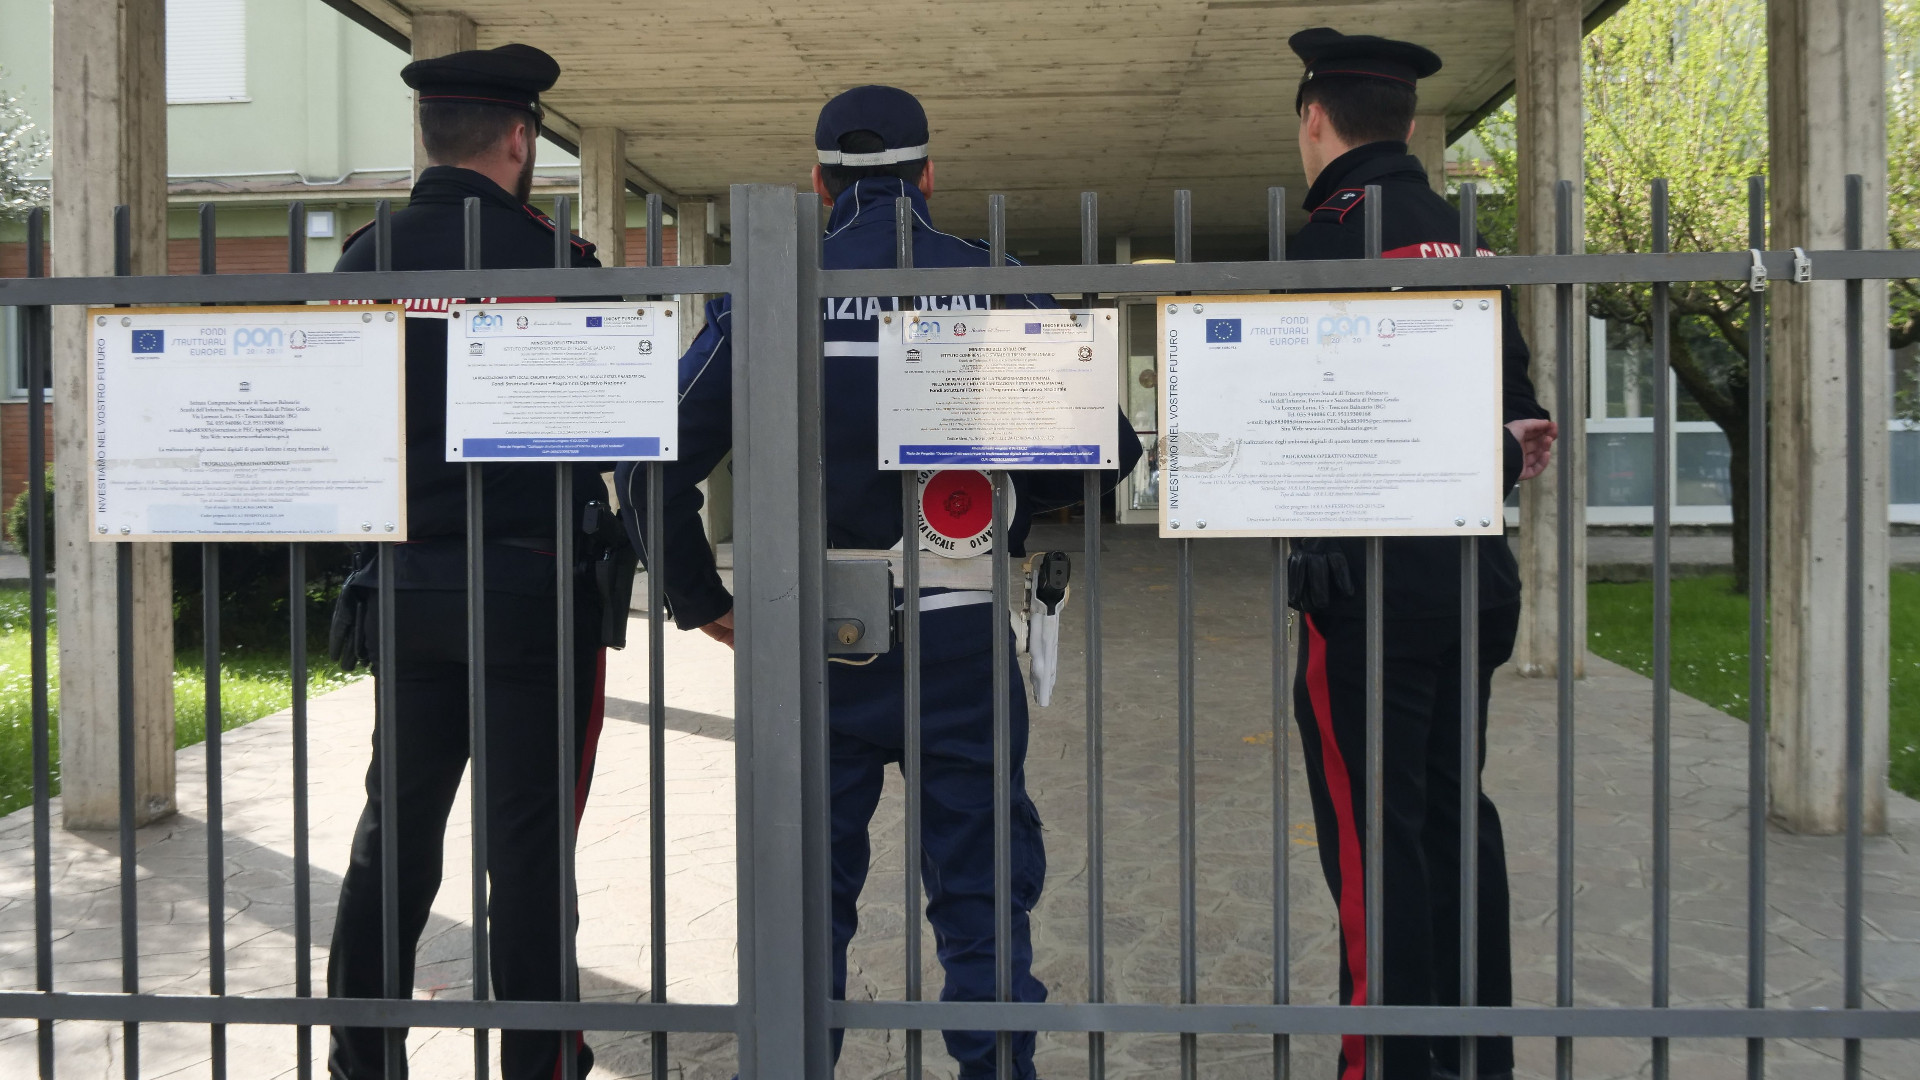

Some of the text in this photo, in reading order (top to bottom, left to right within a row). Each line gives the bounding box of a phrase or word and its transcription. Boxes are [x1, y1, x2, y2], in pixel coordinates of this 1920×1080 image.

[824, 297, 880, 320] IZIA
[1280, 316, 1309, 325] FONDI
[200, 328, 226, 336] FONDI
[1250, 326, 1309, 335] STRUTTURALI
[1317, 316, 1371, 344] pon
[171, 338, 226, 346] STRUTTURALI
[233, 327, 283, 355] pon
[1270, 337, 1309, 345] EUROPEI
[190, 348, 226, 356] EUROPEI
[97, 338, 106, 512] INVESTIAMO NEL VOSTRO FUTURO
[1169, 329, 1178, 509] INVESTIAMO NEL VOSTRO FUTURO
[925, 530, 956, 550] LOCALE
